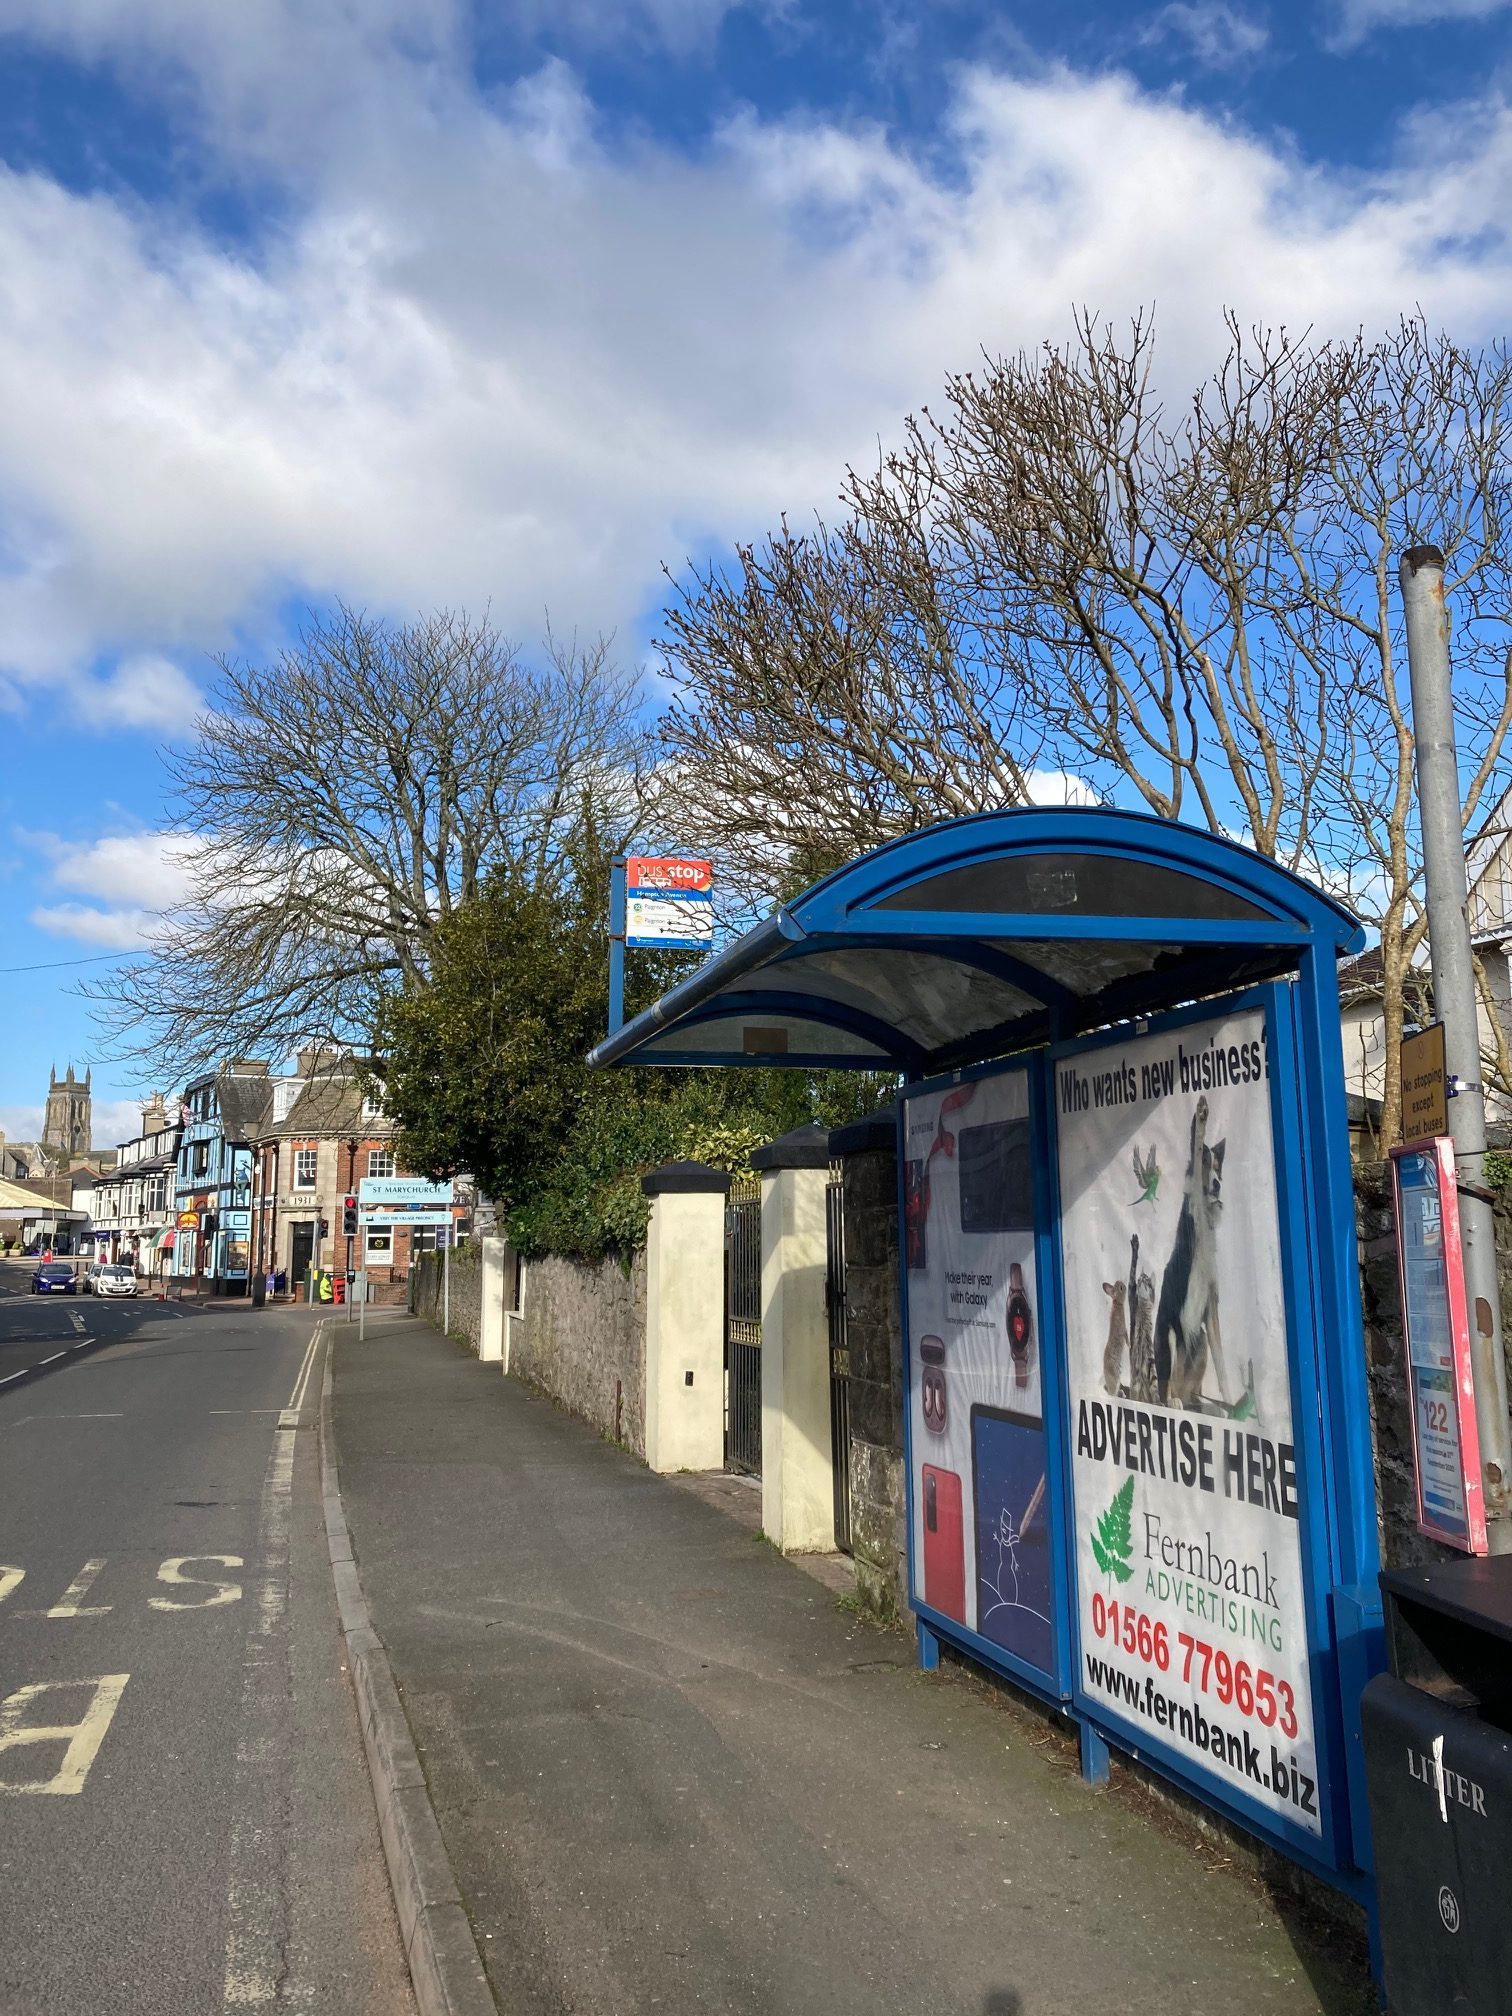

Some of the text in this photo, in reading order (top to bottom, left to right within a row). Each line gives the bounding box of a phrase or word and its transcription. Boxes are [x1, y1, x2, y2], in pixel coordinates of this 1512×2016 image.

[637, 861, 704, 883] bus stop
[1060, 1069, 1089, 1114] Who
[1093, 1058, 1136, 1108] wants
[1141, 1059, 1174, 1100] new
[1403, 1067, 1443, 1093] No stopping
[1412, 1095, 1434, 1114] except
[1405, 1116, 1443, 1138] local buses
[945, 1271, 961, 1284] Make
[965, 1291, 988, 1310] Galaxy
[1424, 1400, 1449, 1433] 122
[1077, 1399, 1299, 1520] ADVERTISE HERE
[1143, 1512, 1280, 1610] Fernbank
[1145, 1568, 1282, 1652] ADVERTISING
[1092, 1593, 1298, 1739] 01566 779653
[1086, 1653, 1317, 1816] www.fernbank.biz
